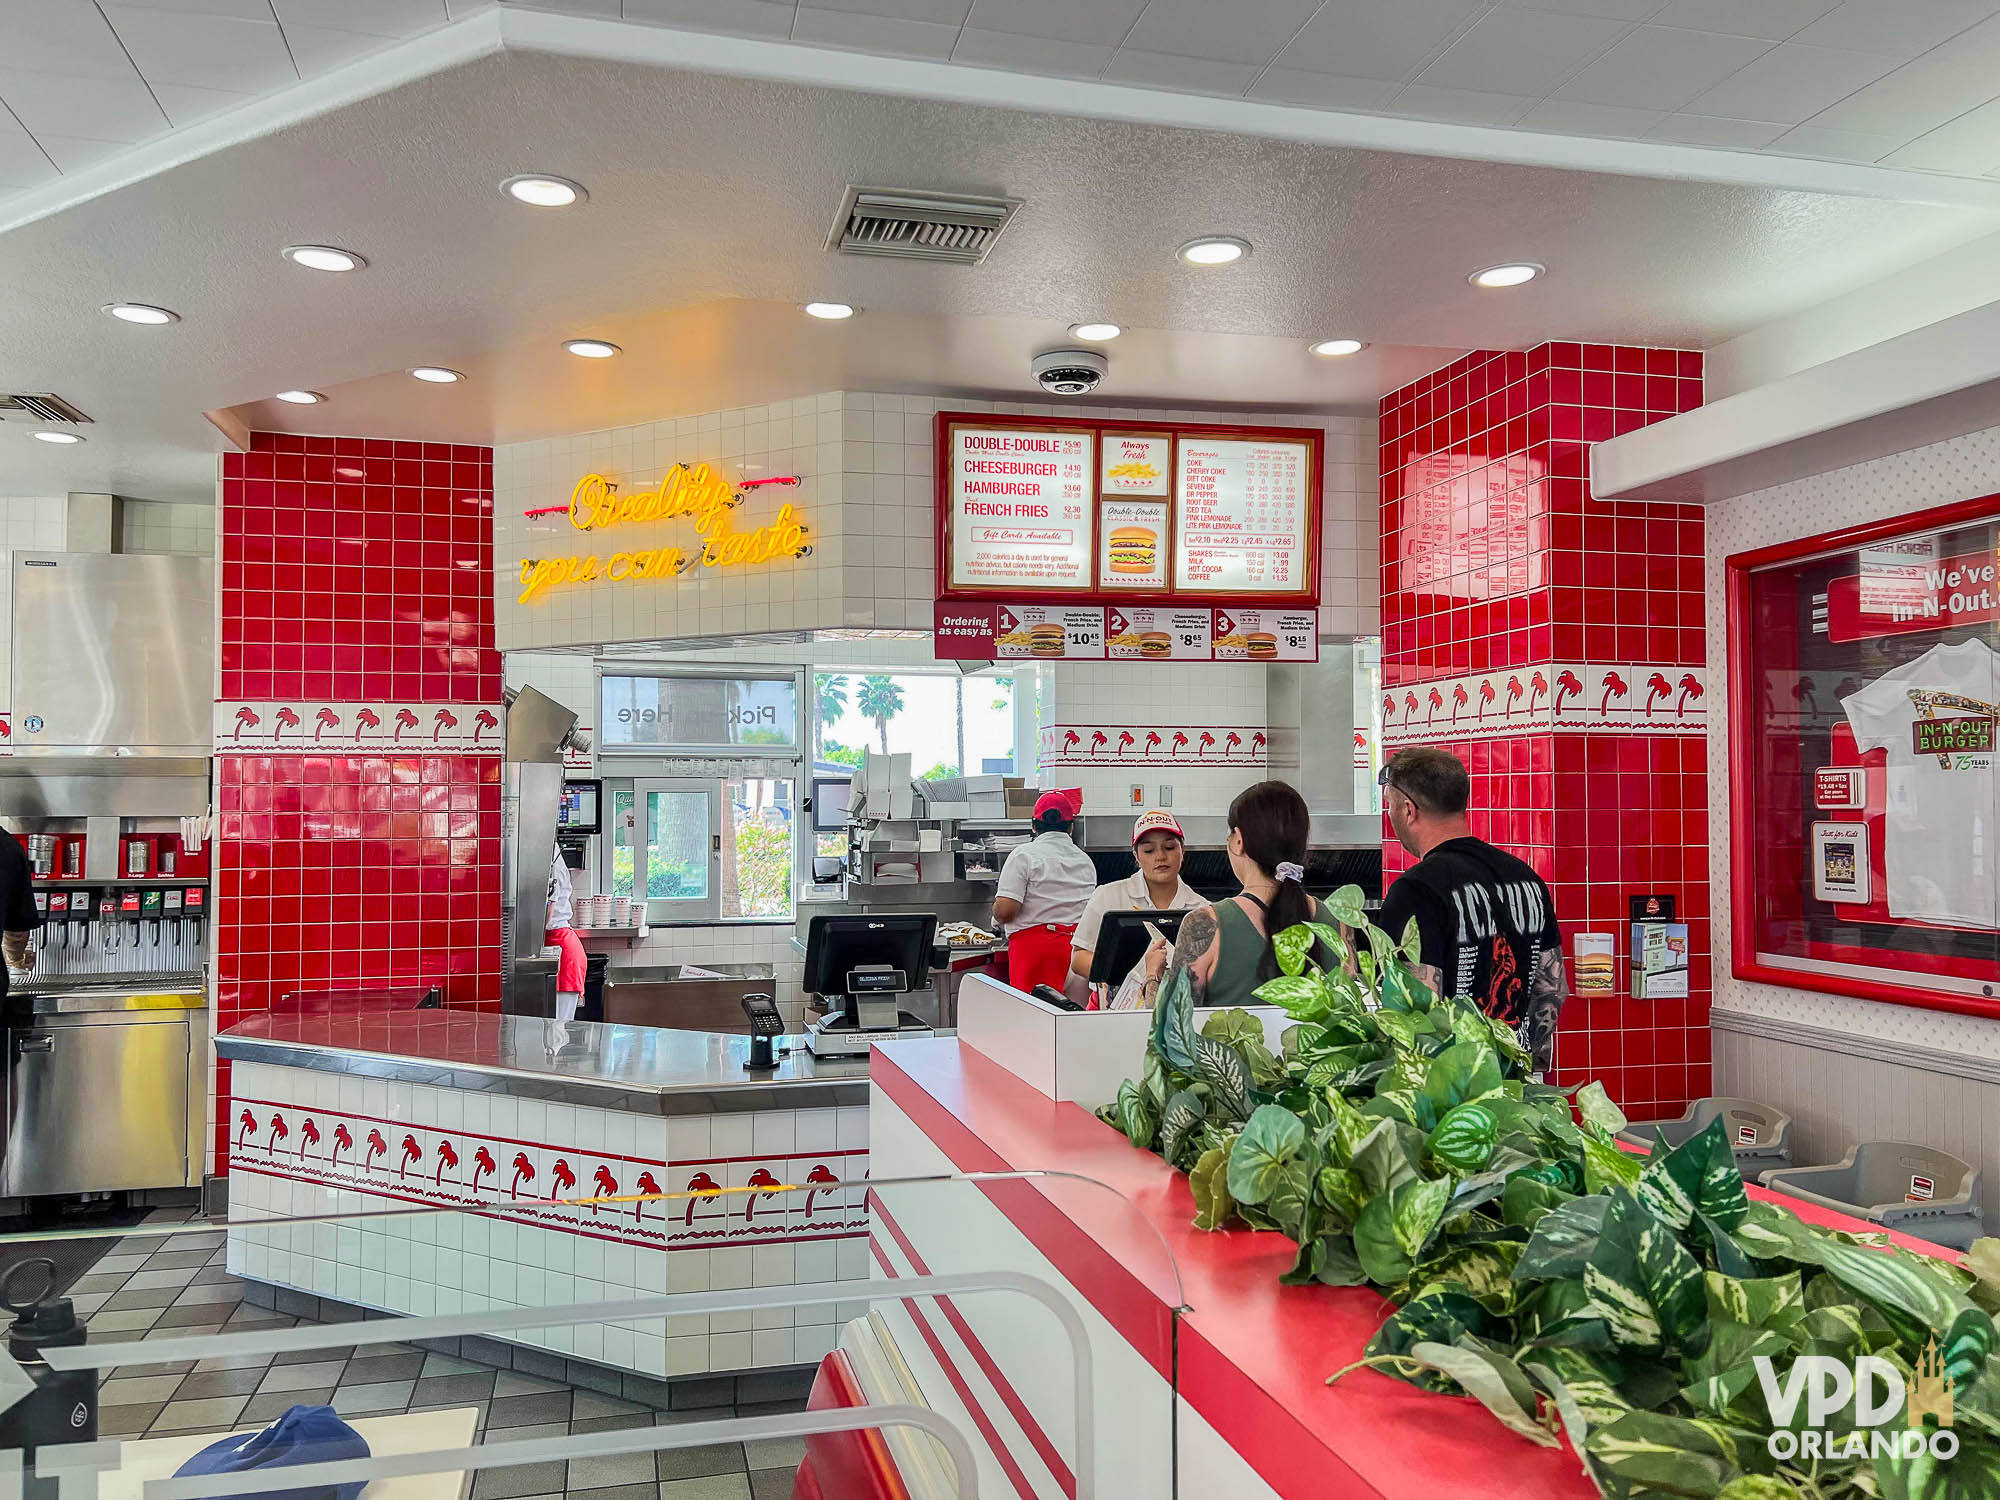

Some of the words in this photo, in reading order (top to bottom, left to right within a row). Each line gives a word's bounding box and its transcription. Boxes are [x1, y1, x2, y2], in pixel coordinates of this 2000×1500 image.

[964, 436, 1060, 453] DOUBLE-DOUBLE
[1064, 440, 1081, 448] $5.90
[1121, 441, 1150, 450] Always
[1123, 450, 1146, 459] Fresh
[964, 460, 1058, 476] CHEESEBURGER
[964, 481, 1041, 496] HAMBURGER
[569, 463, 735, 534] Quality
[964, 502, 1012, 517] FRENCH
[1015, 504, 1049, 518] FRIES
[1108, 506, 1160, 515] Double-Double
[983, 530, 999, 540] Gift
[1000, 530, 1023, 540] Cards
[1025, 532, 1063, 540] Available
[518, 555, 598, 604] you
[607, 548, 681, 581] can
[702, 504, 803, 567] taste
[1924, 564, 1995, 591] We've
[1892, 588, 2000, 622] In-N-Out.
[943, 616, 989, 628] Ordering
[1000, 614, 1012, 629] 1
[1111, 616, 1122, 630] 2
[1218, 616, 1230, 632] 3
[954, 628, 978, 638] easy
[980, 628, 993, 636] as
[1919, 721, 1992, 736] IN-N-OUT
[1920, 735, 1989, 750] BURGER
[1955, 755, 1974, 770] 75
